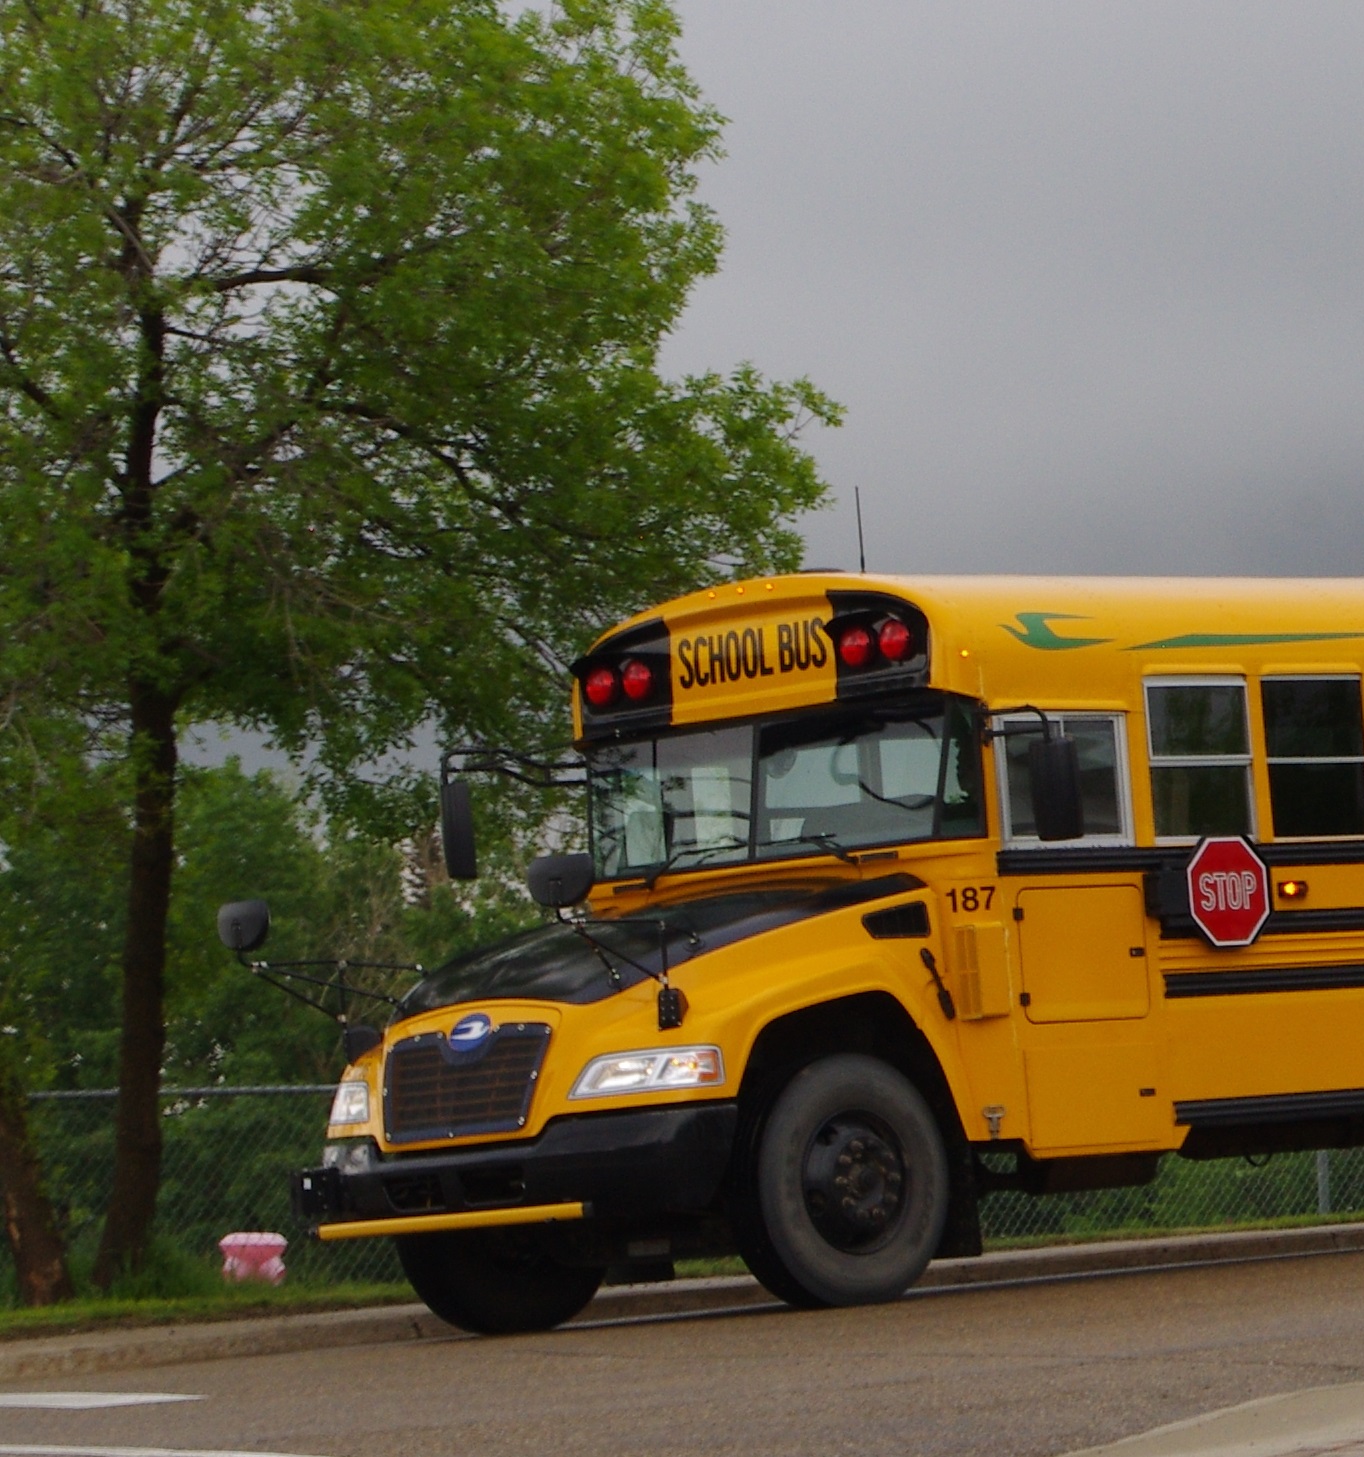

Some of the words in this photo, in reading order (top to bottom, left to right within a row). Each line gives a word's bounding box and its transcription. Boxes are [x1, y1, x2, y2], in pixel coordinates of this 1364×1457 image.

[678, 627, 774, 689] SCHOOL
[778, 617, 828, 673] BUS
[946, 886, 996, 913] 187
[1199, 871, 1257, 912] STOP
